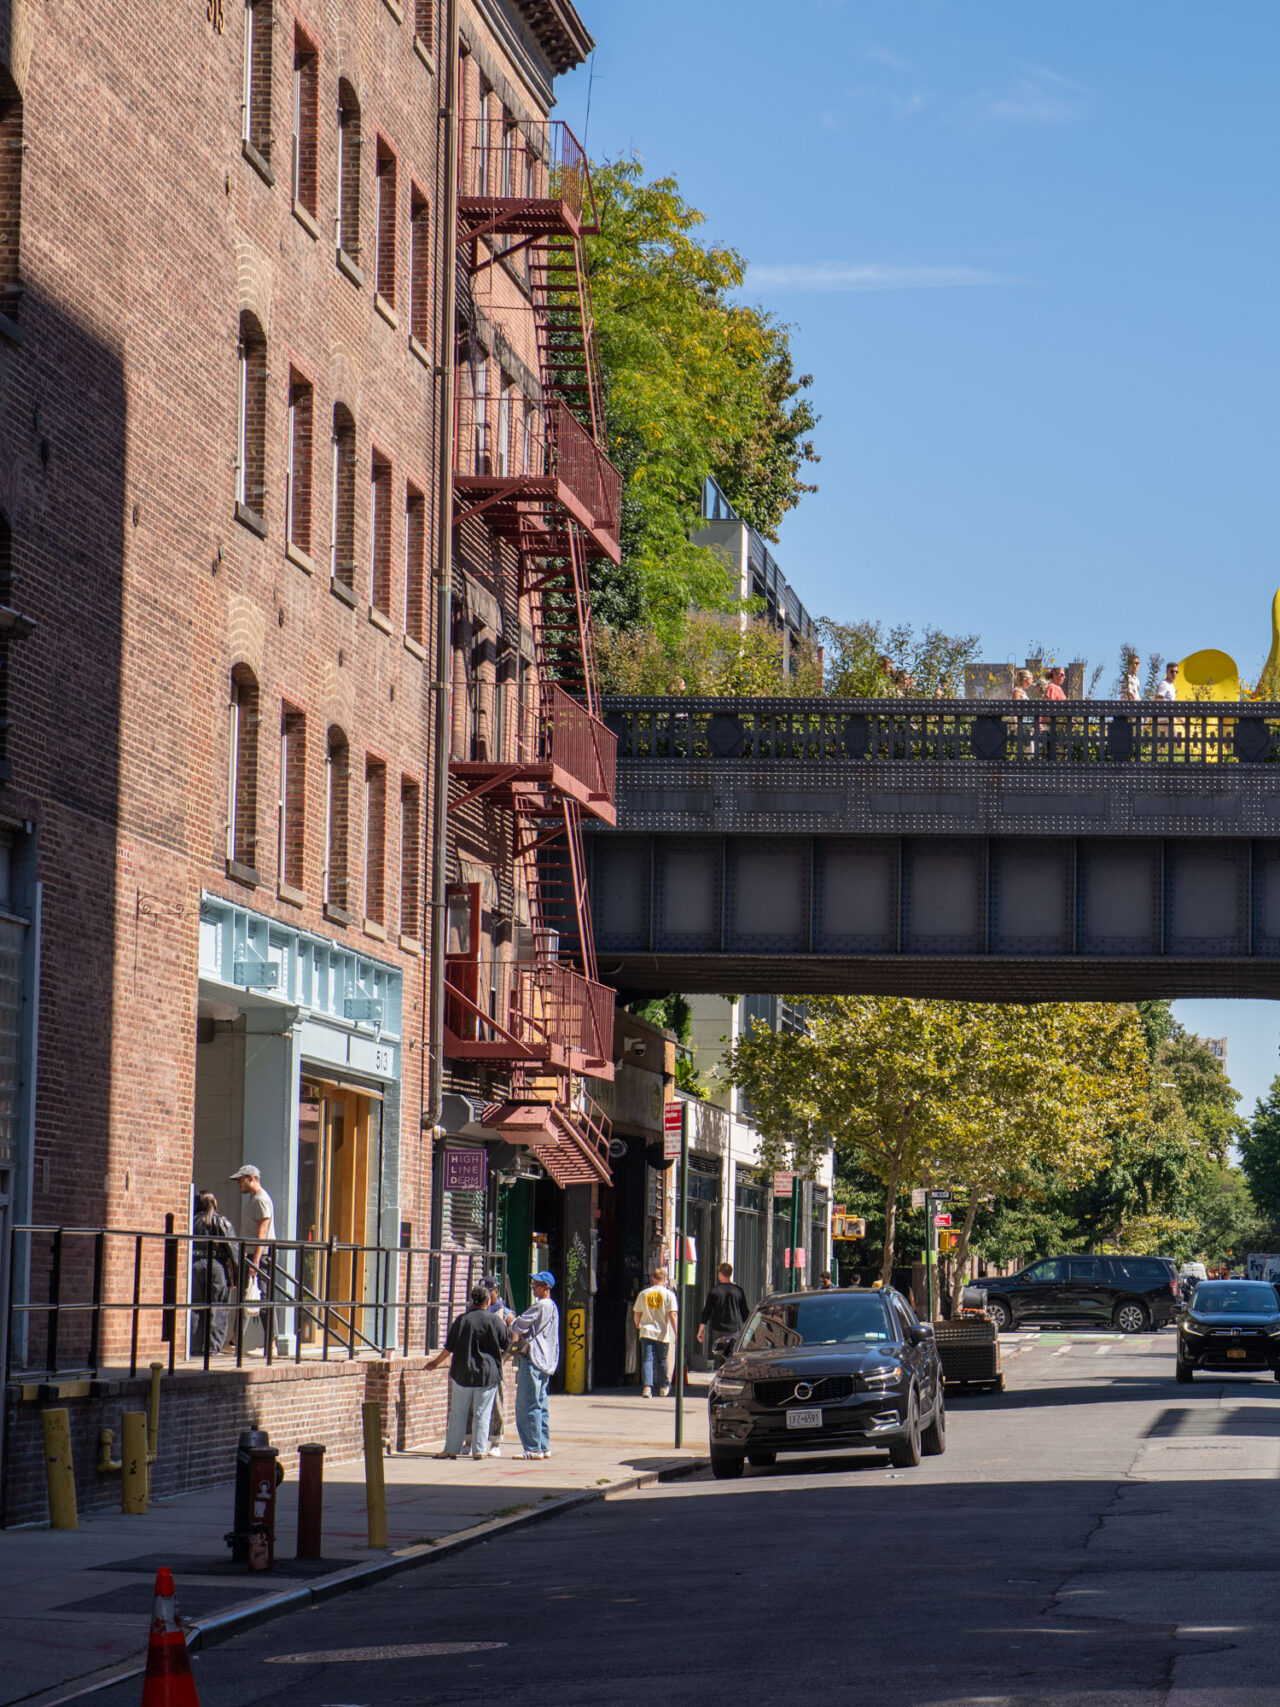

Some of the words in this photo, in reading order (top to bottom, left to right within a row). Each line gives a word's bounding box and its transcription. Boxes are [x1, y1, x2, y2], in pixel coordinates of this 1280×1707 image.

[376, 1050, 388, 1071] 513
[451, 1155, 479, 1163] HIGH
[451, 1166, 479, 1174] LINE
[450, 1176, 479, 1185] DERM
